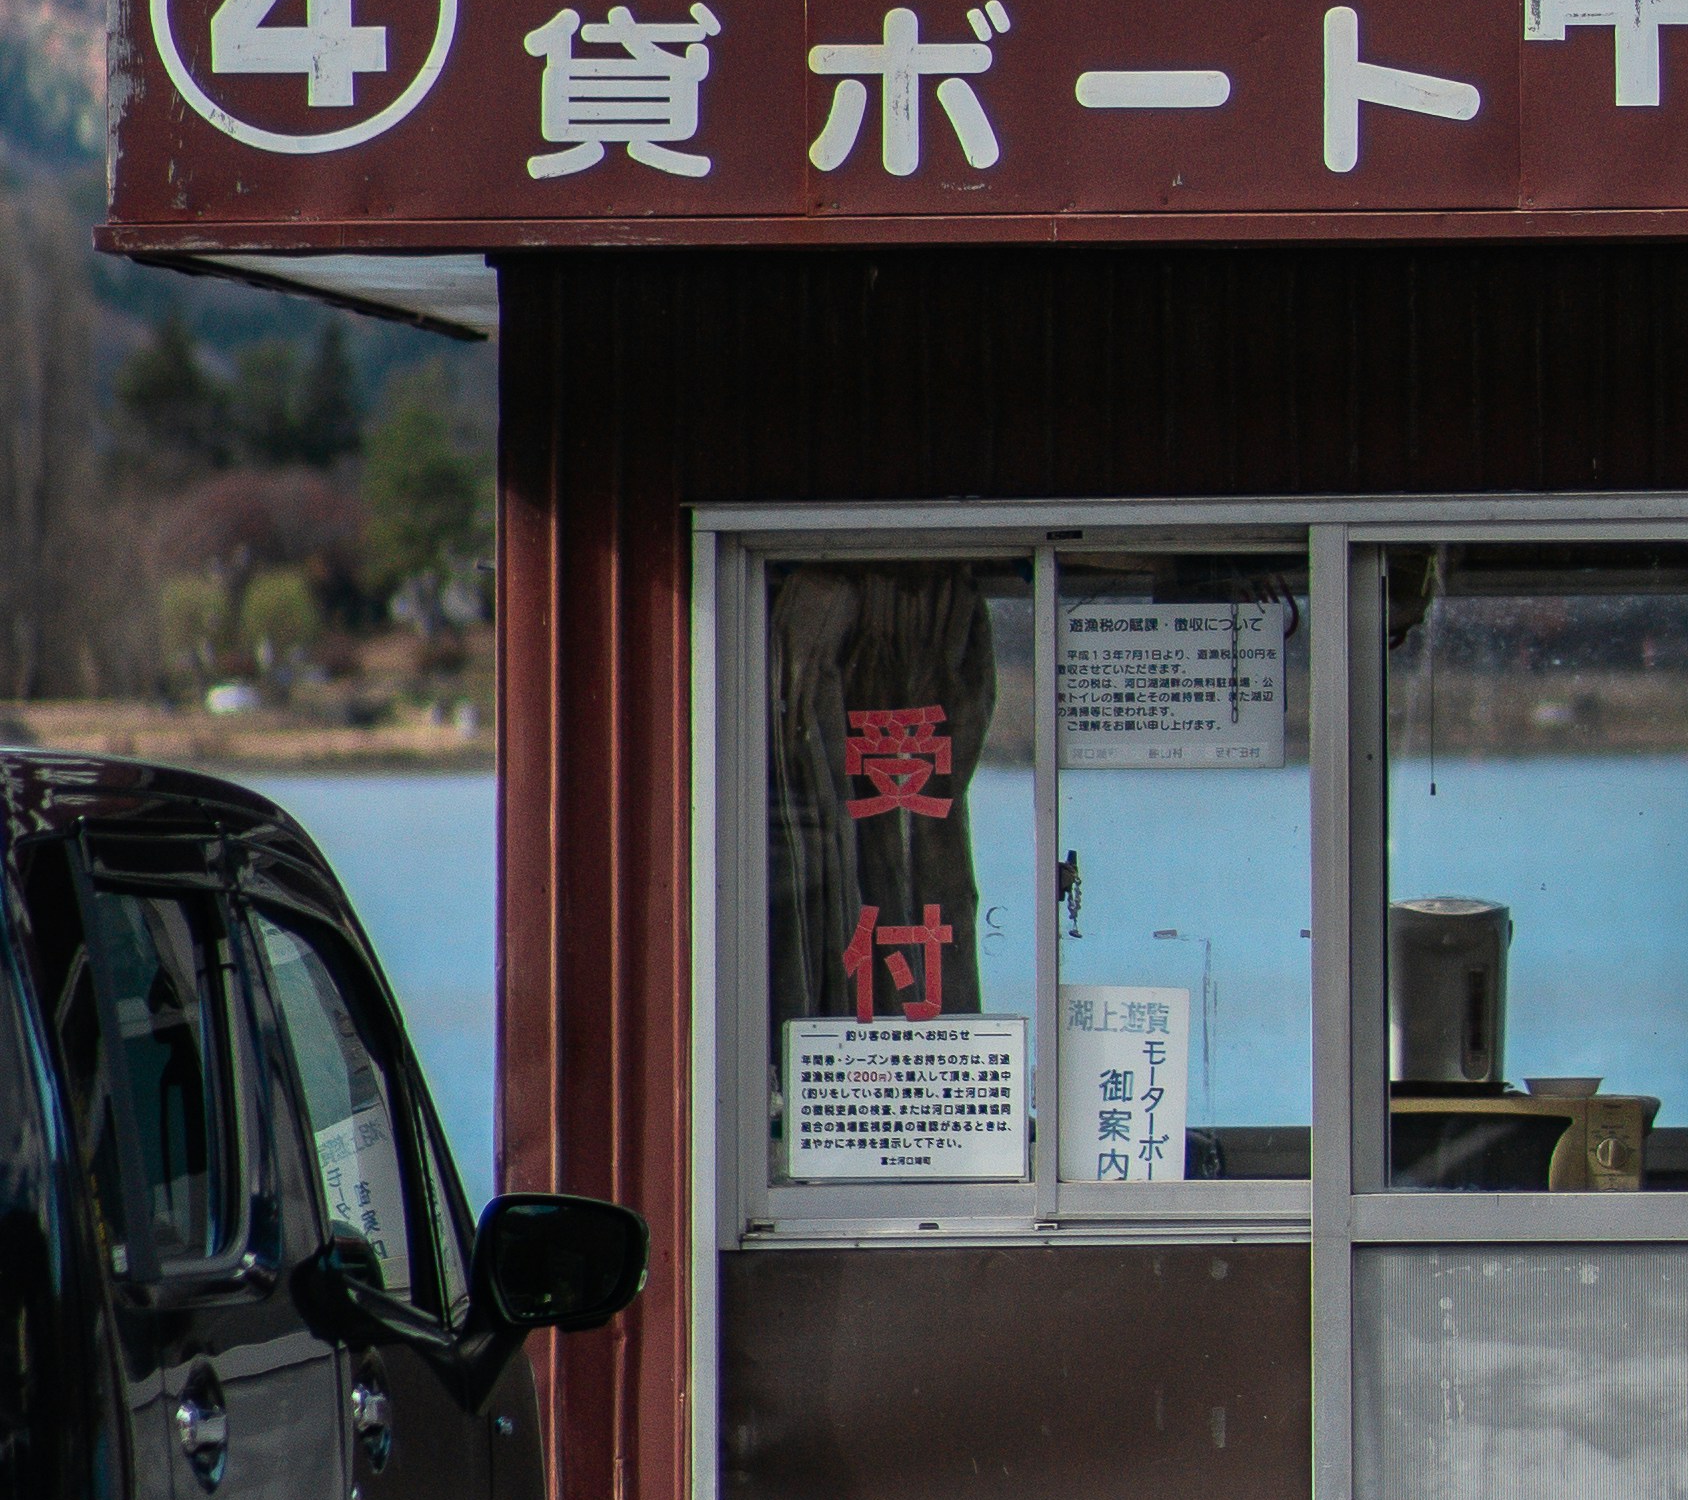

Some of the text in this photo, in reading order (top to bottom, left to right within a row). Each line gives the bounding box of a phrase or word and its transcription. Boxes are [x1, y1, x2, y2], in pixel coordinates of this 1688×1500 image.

[523, 0, 1482, 180] 貸ボート
[1067, 719, 1222, 731] ご理解をお願い申し上げます。
[844, 704, 953, 1023] 受付
[845, 1029, 970, 1042] 釣り客の皆様へお知らせ
[1067, 999, 1170, 1035] 湖上遊覧
[1097, 1068, 1135, 1180] 御案内
